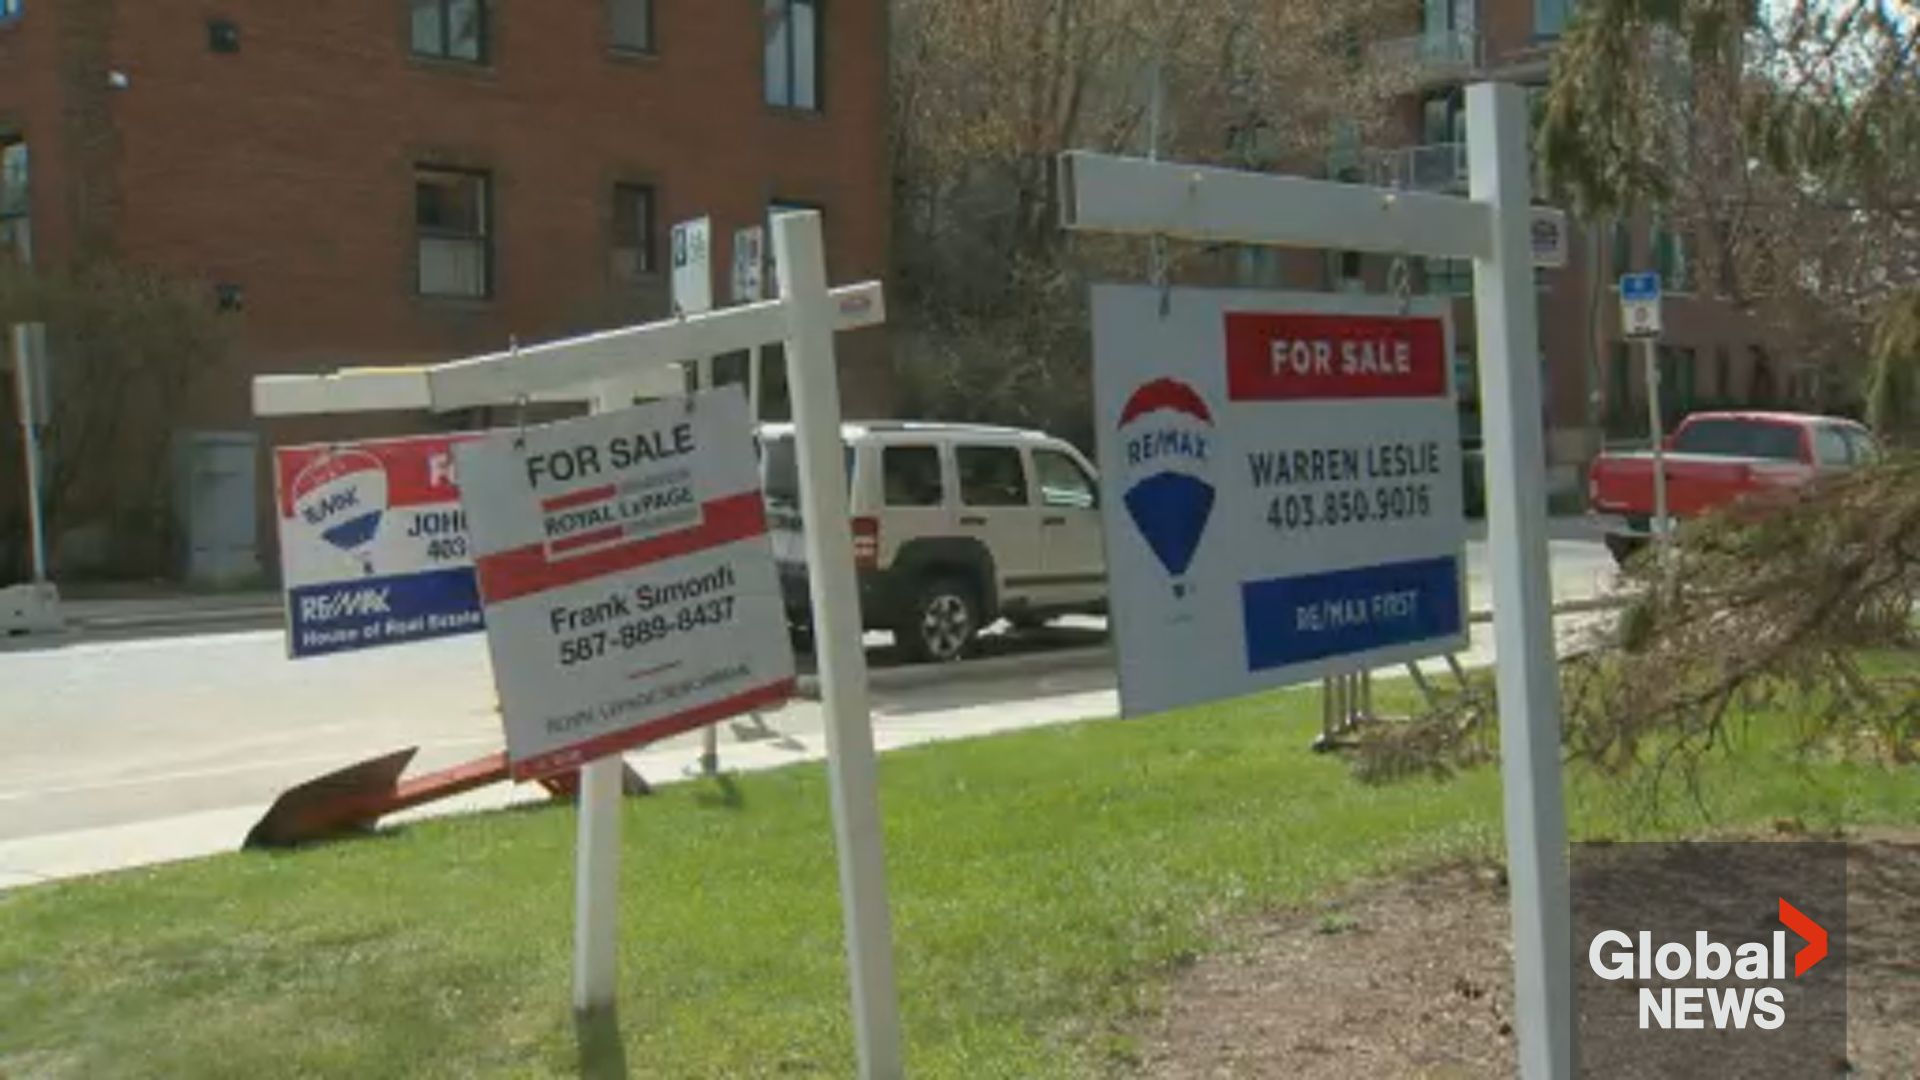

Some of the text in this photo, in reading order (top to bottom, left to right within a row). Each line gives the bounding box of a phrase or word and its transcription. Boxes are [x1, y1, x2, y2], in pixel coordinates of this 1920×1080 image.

[1270, 338, 1412, 375] FOR SALE
[527, 424, 695, 488] FOR SALE
[1128, 430, 1208, 465] RE/MAX
[1249, 442, 1440, 488] WARREN LESLIE
[542, 508, 614, 536] ROYAL
[302, 587, 390, 622] RE/MAX
[550, 597, 631, 634] Frank
[1295, 590, 1418, 631] RE/MAX FIRST
[303, 607, 481, 646] House of Real Estate
[560, 596, 736, 667] 587-889-8437
